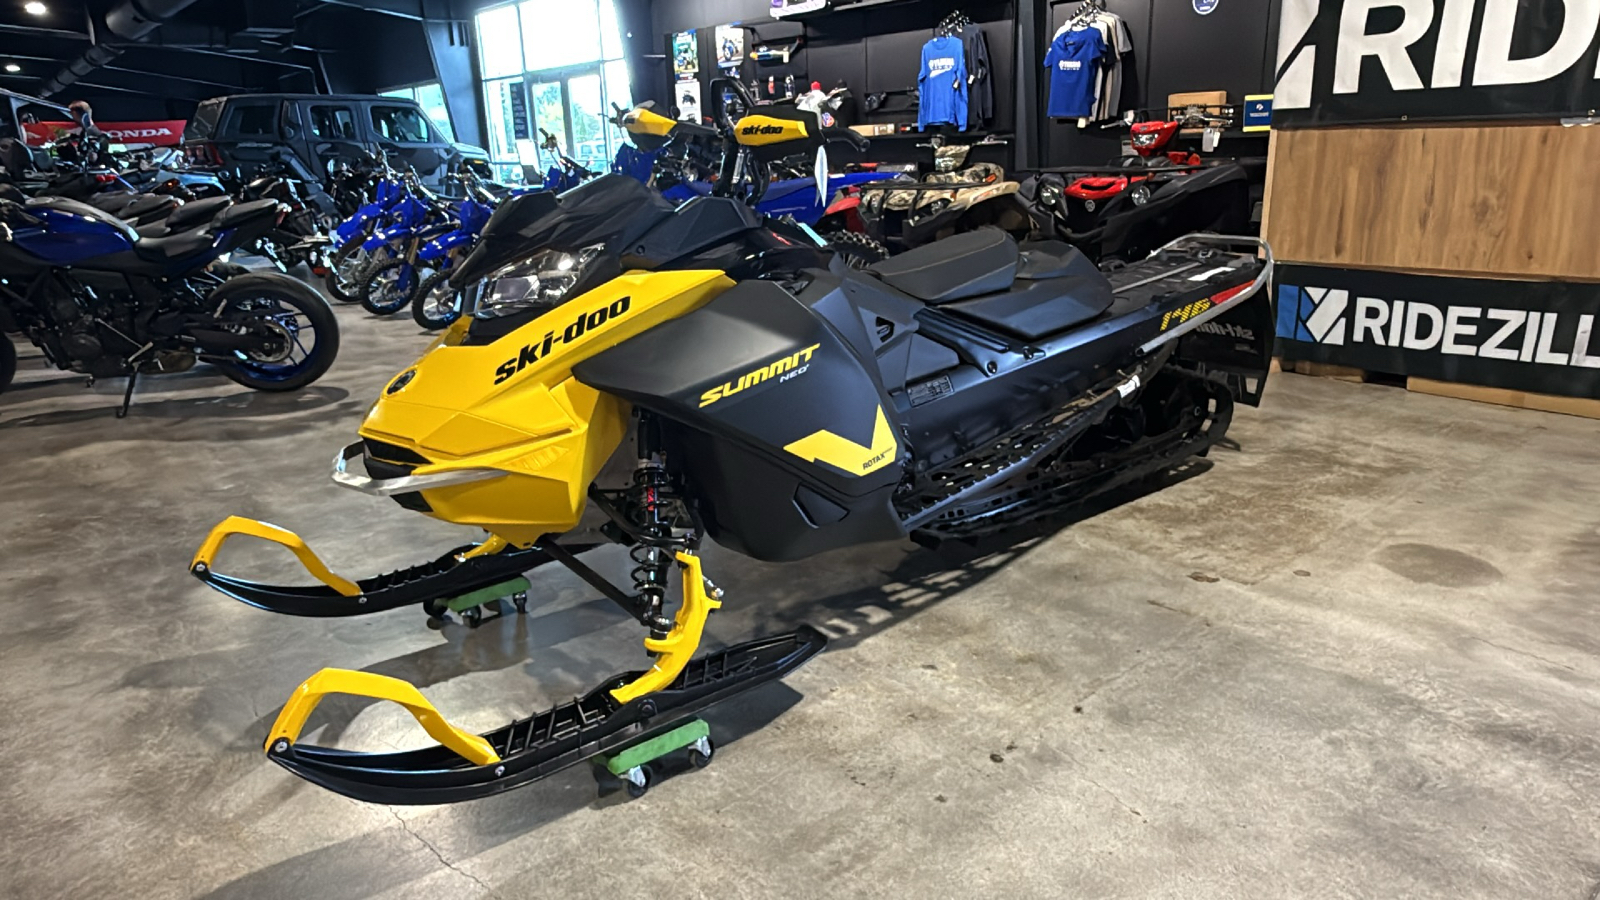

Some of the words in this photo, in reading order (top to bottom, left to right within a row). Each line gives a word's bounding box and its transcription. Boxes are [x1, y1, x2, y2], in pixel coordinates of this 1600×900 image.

[1333, 0, 1600, 94] RID
[102, 127, 173, 139] ONDA
[742, 124, 784, 135] ski-doo
[494, 296, 631, 386] ski-doo
[1353, 297, 1600, 369] RIDEZILL
[699, 342, 821, 409] SUMMIT
[862, 452, 886, 471] ROTAX
